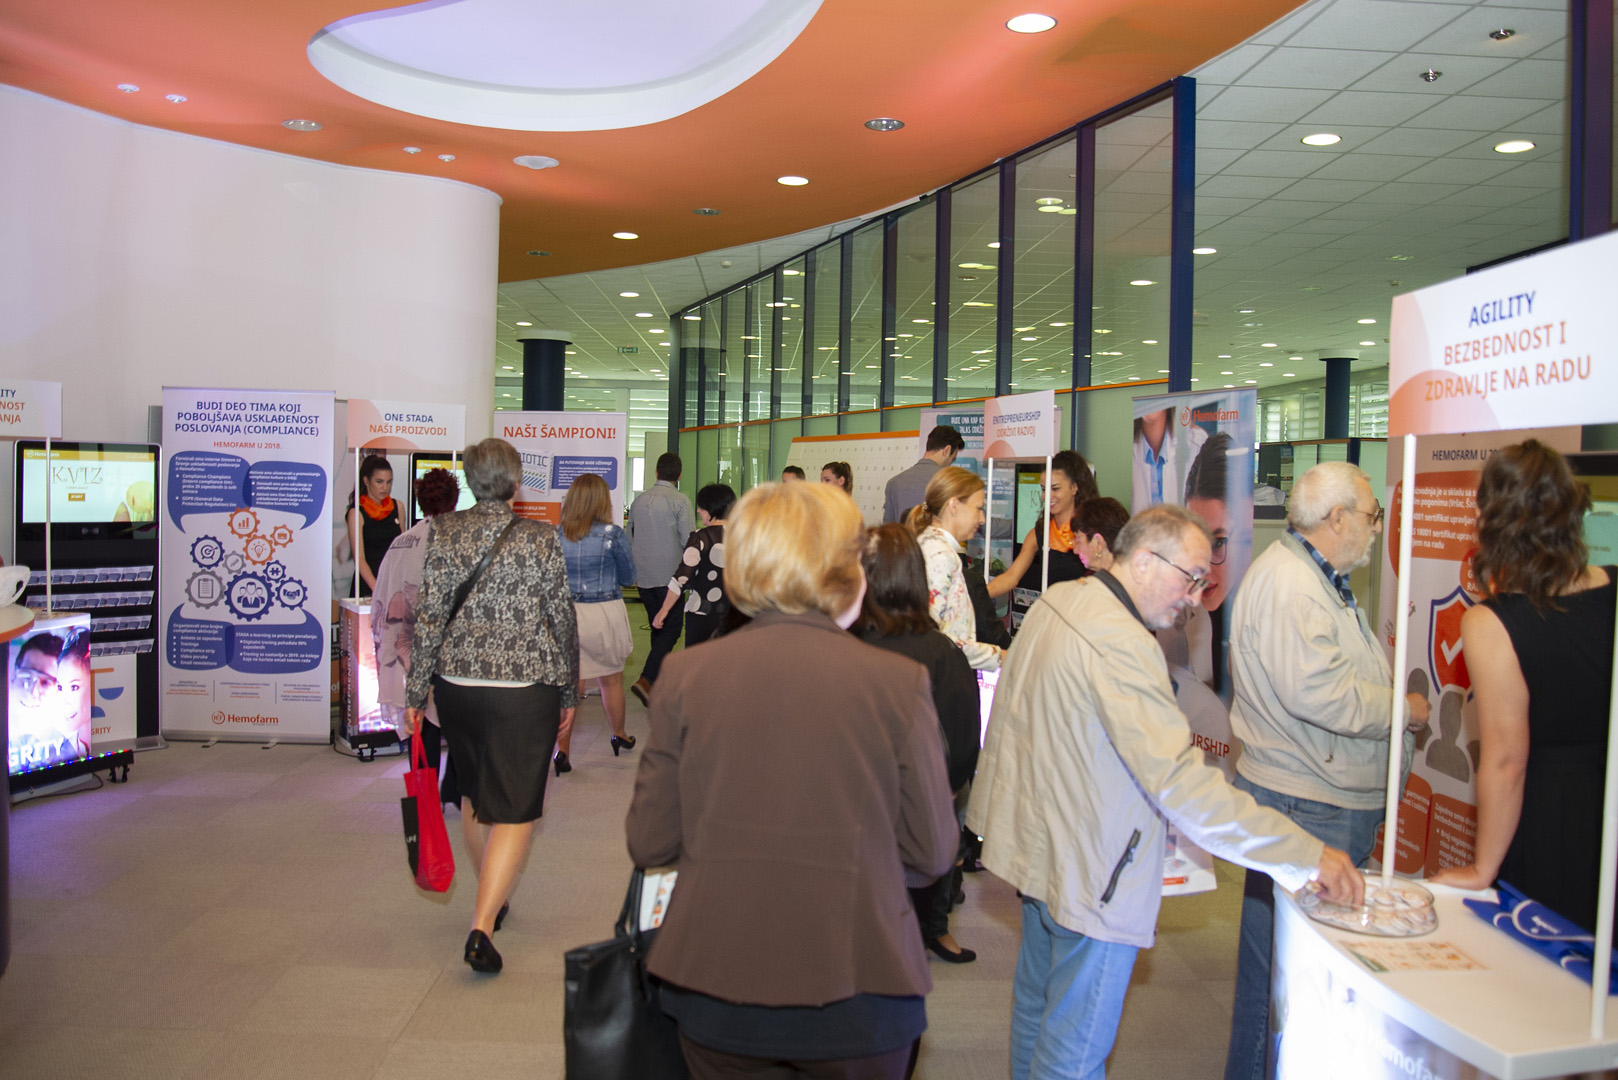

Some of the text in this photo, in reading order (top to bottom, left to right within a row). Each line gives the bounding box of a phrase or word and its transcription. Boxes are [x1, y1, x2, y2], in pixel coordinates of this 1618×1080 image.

[1468, 290, 1536, 328] AGILITY
[1444, 321, 1567, 366] BEZBEDNOST I
[1424, 354, 1591, 402] ZDRAVLJE NA RADU
[0, 388, 16, 398] ITY
[0, 401, 26, 411] NOST
[196, 401, 301, 414] BUDI DEO TIMA KOJI
[177, 411, 320, 424] POBOLJŠAVA USKLAĐENOST
[384, 413, 434, 423] ONE STADA
[992, 411, 1041, 425] ENTREPRENEURSHIP
[1192, 408, 1239, 422] Hemofarm
[175, 424, 319, 437] POSLOVANJA (COMPLIANCE)
[369, 424, 447, 436] NAŠI PROIZVODI
[503, 424, 616, 439] NAŠI ŠAMPIONI!
[1017, 426, 1036, 437] RAZVOJ
[1432, 449, 1478, 460] HEMOFARM
[1480, 450, 1487, 460] U
[52, 466, 104, 484] KVIZ
[228, 714, 279, 724] Hemofarm
[9, 736, 64, 768] GRITY
